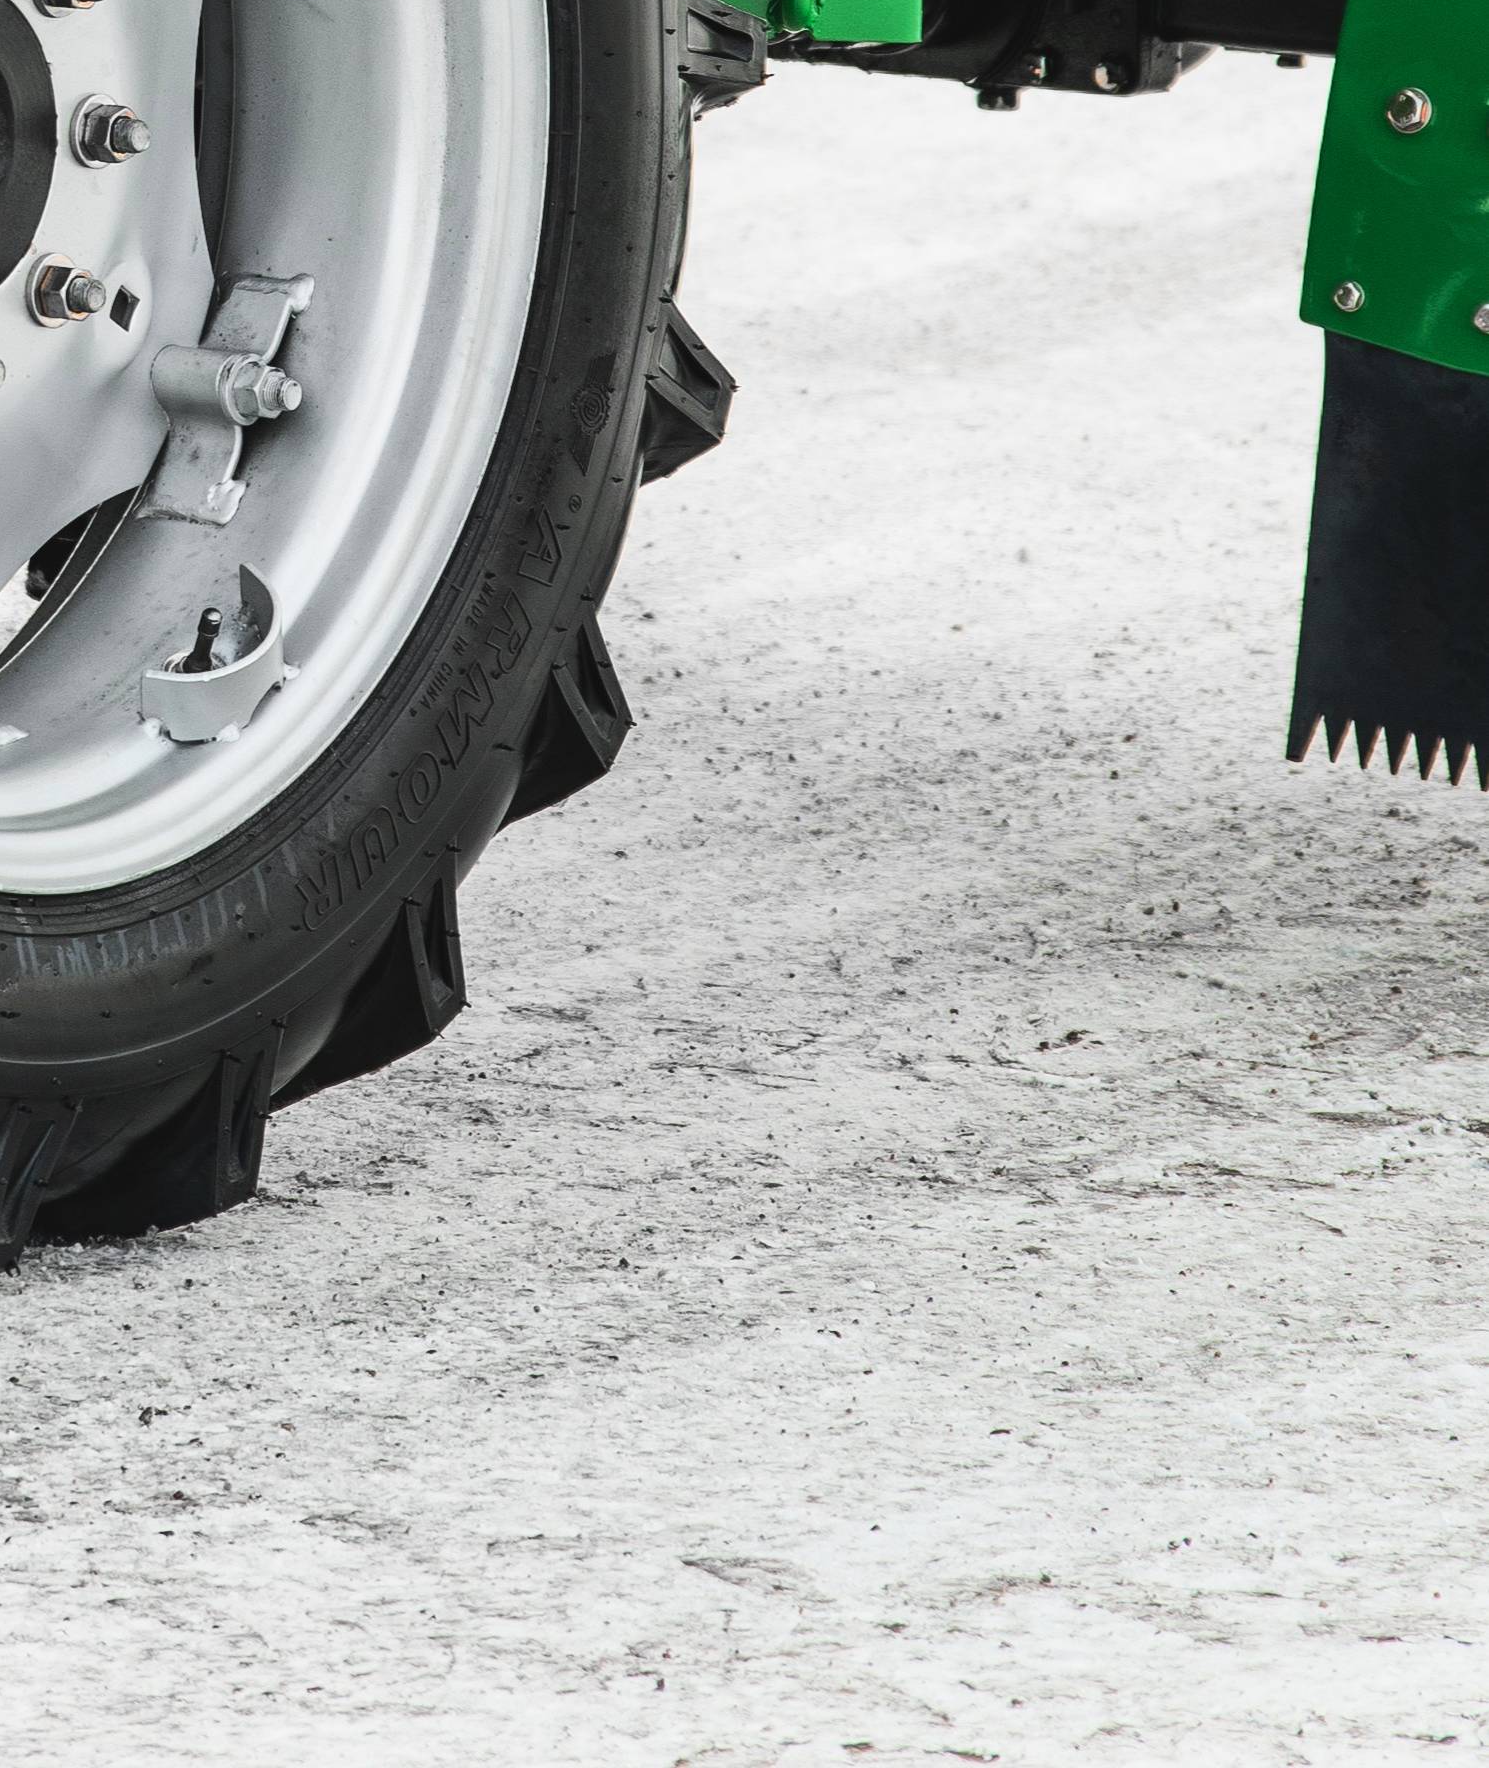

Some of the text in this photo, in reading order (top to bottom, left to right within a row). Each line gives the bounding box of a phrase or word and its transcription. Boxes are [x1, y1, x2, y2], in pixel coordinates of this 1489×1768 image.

[295, 503, 563, 932] ARMOUR
[418, 581, 497, 710] MADE IN CHINA
